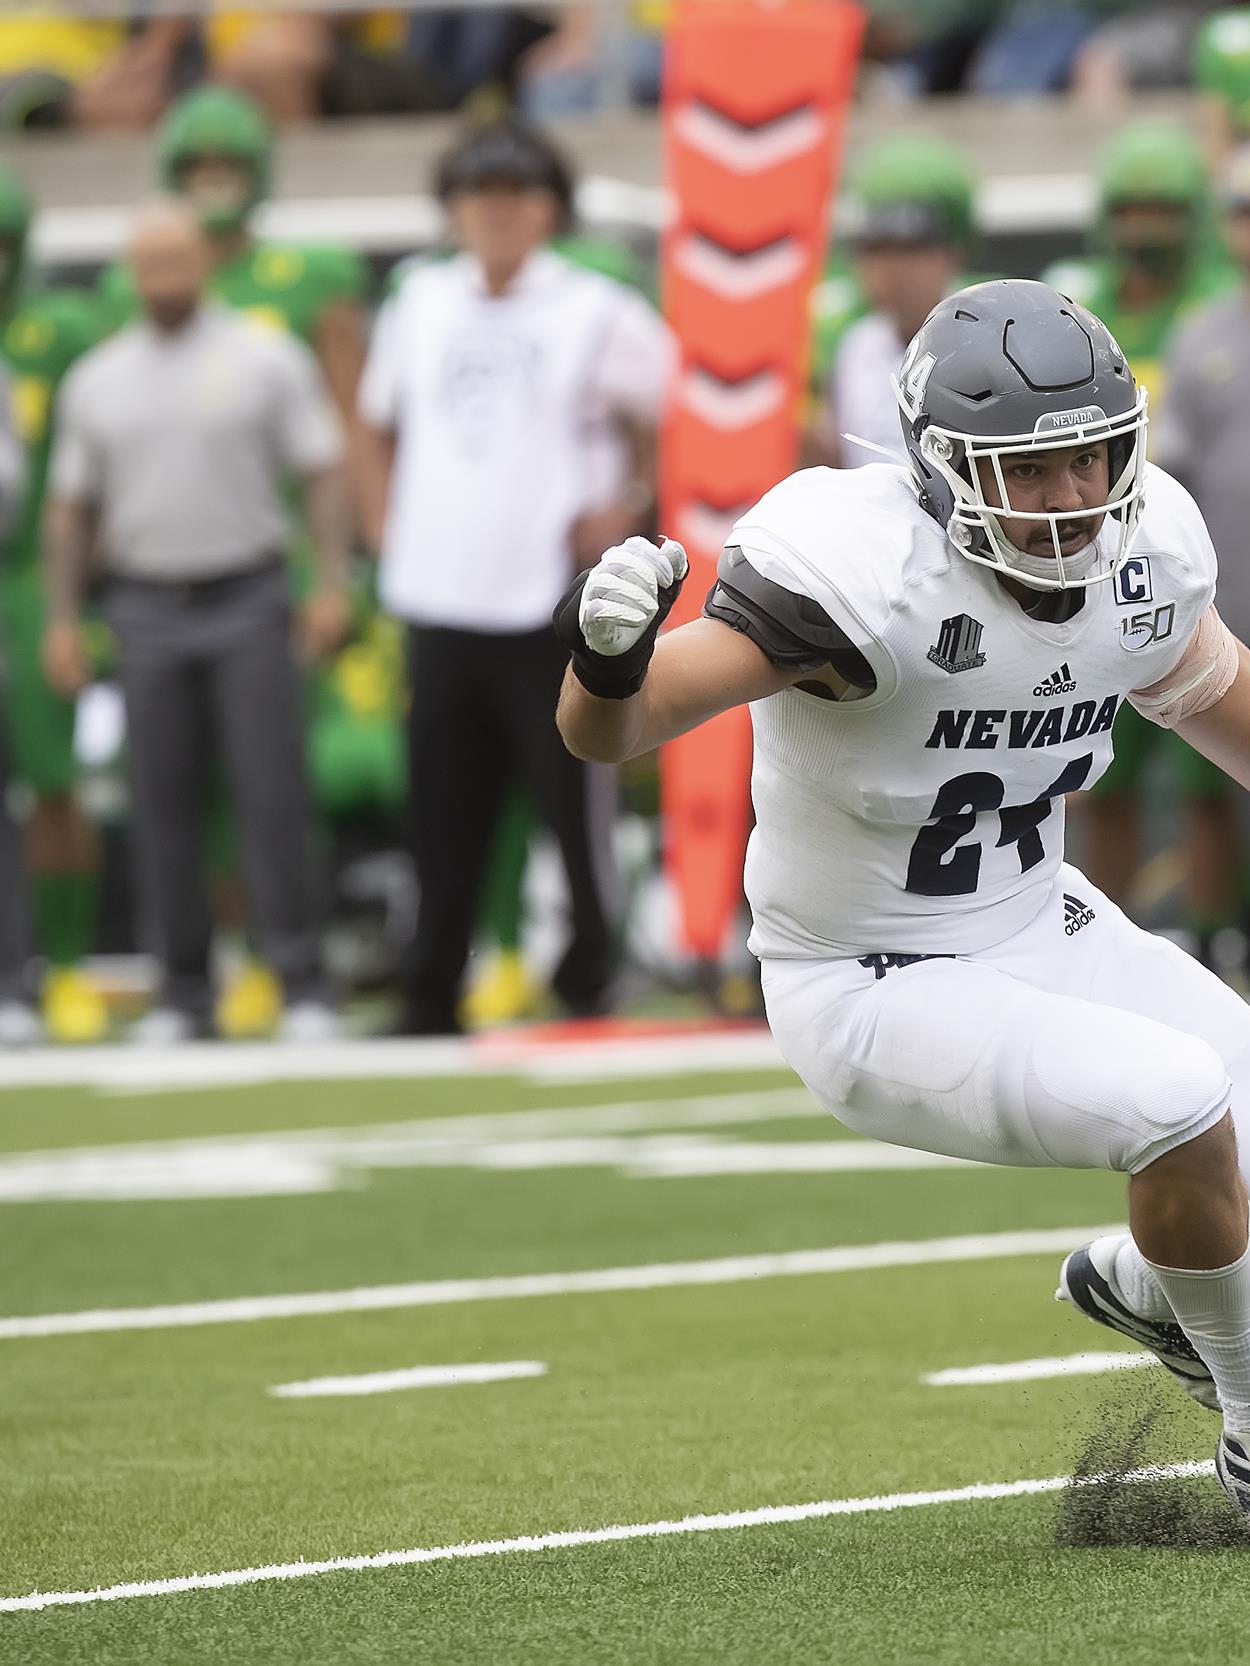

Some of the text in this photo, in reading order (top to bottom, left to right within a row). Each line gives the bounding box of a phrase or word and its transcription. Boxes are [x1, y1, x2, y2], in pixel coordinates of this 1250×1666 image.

[1052, 411, 1094, 427] NEVADA
[1119, 560, 1146, 600] C
[1120, 602, 1175, 651] 150
[1033, 681, 1077, 697] adidas
[924, 693, 1120, 749] NEVADA
[906, 751, 1093, 897] 24
[1065, 909, 1096, 936] adidas
